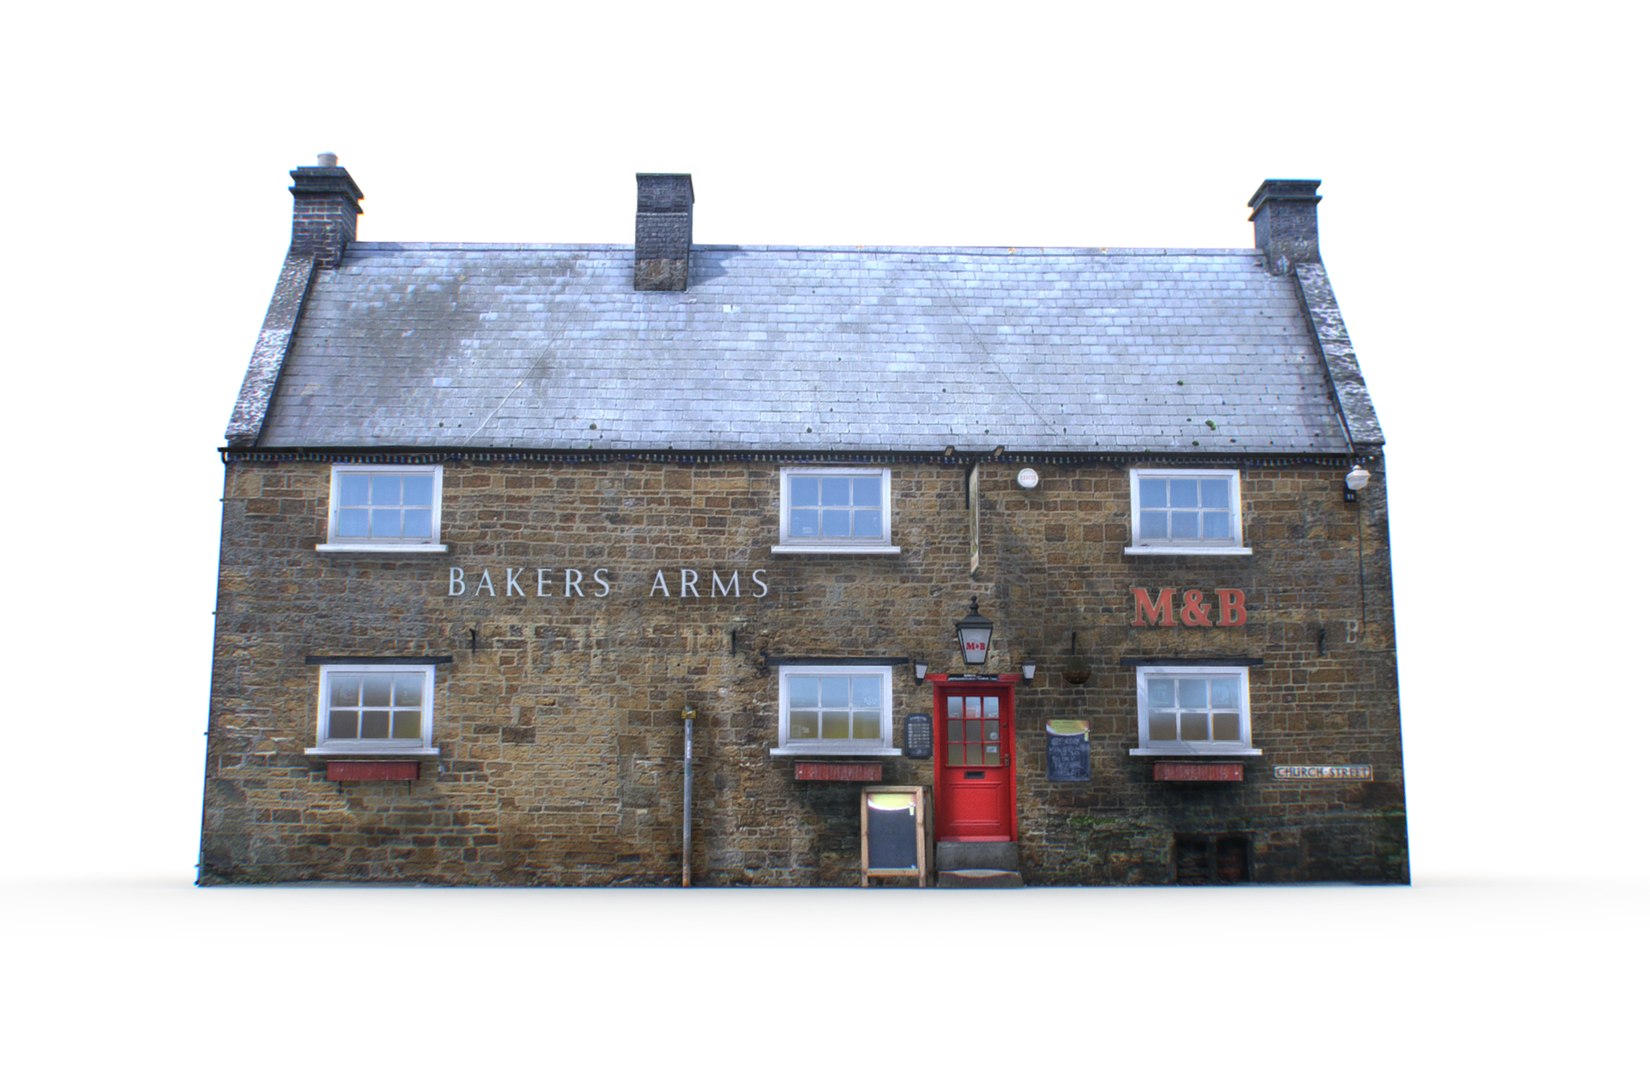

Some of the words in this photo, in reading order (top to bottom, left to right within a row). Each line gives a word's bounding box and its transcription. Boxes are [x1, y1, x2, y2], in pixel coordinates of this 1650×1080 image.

[447, 567, 610, 598] BAKERS
[649, 568, 769, 598] ARMS
[1130, 586, 1248, 627] M&B
[1276, 767, 1324, 777] CHURCH
[1328, 767, 1369, 778] STREET
